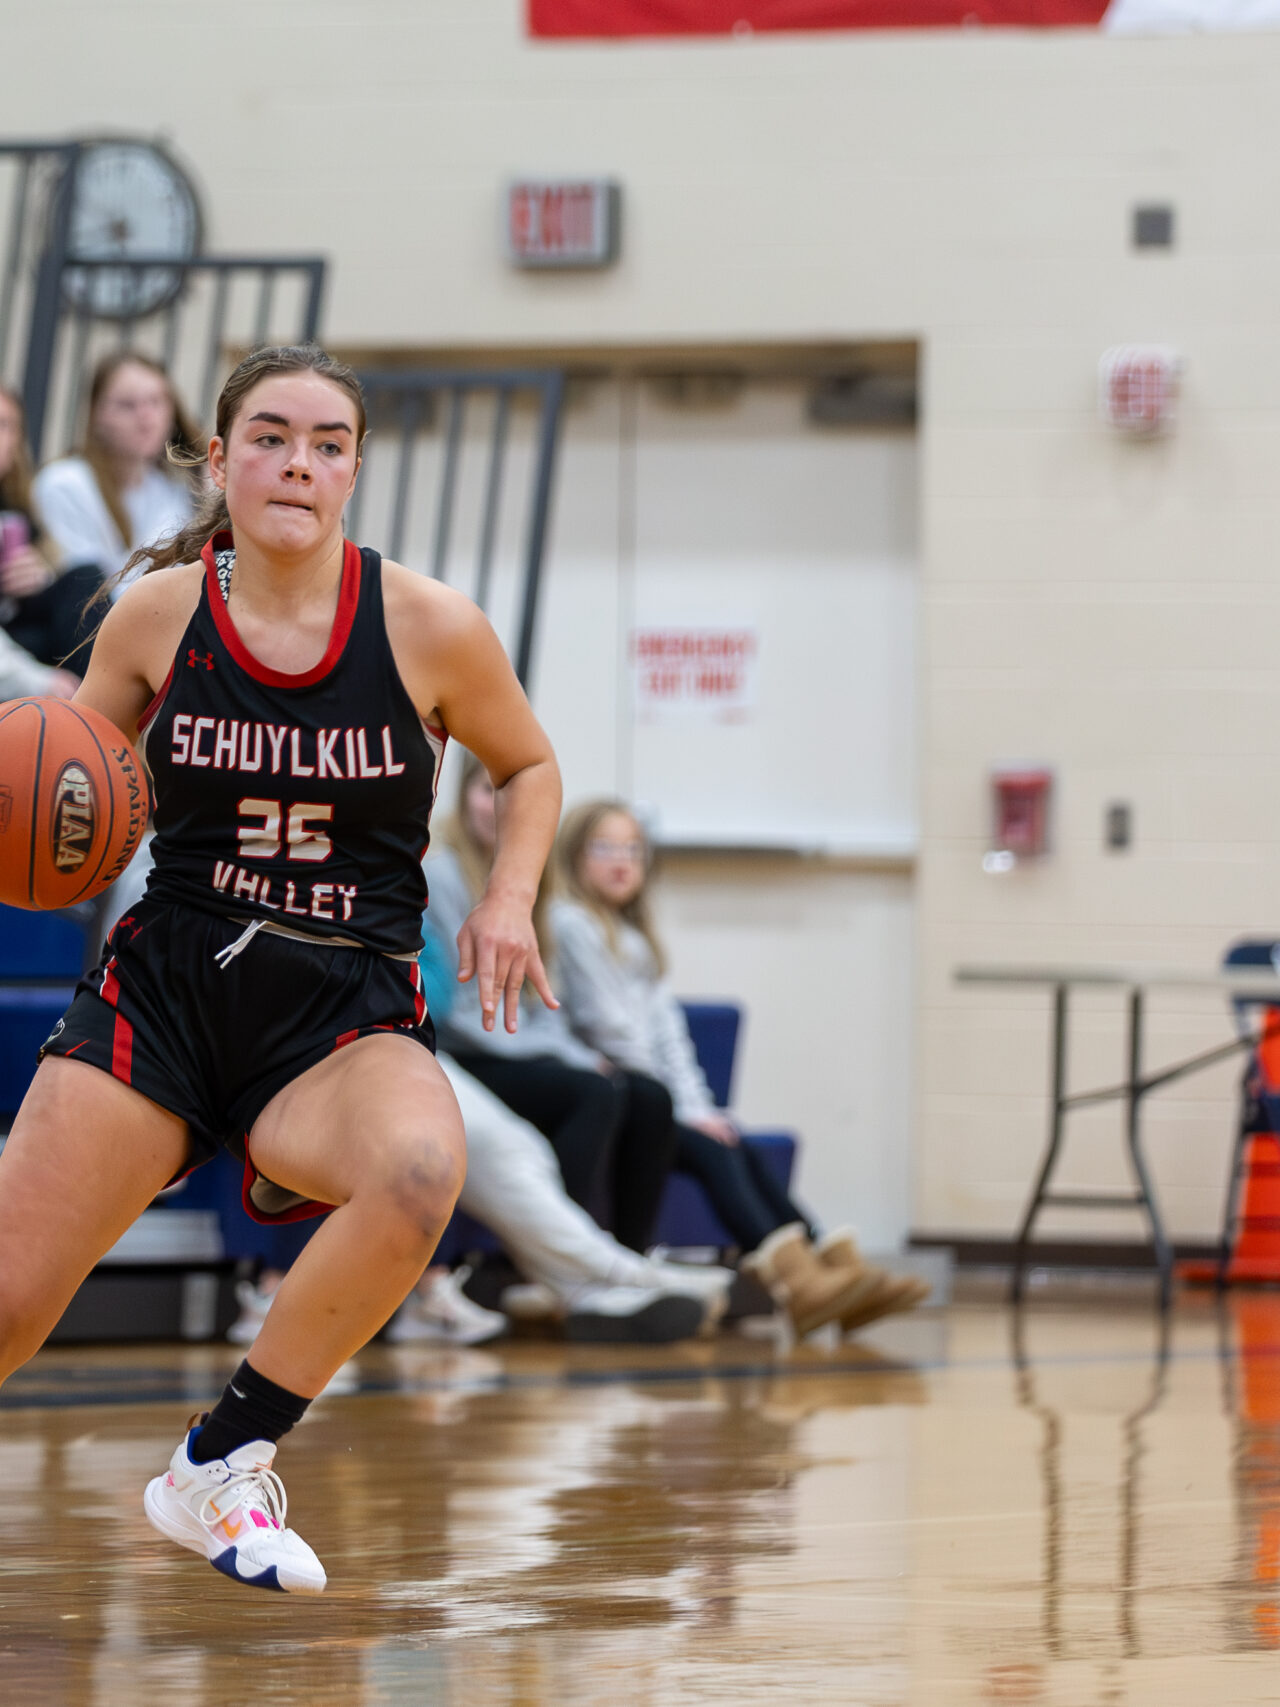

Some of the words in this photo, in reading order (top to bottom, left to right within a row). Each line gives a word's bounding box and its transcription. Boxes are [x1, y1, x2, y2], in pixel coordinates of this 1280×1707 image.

[510, 184, 593, 251] EXIT
[170, 713, 406, 779] SCHUYLKILL
[55, 778, 94, 869] PIAA
[100, 746, 141, 883] SPALDING
[236, 797, 334, 863] 35
[212, 859, 357, 921] VALLEY
